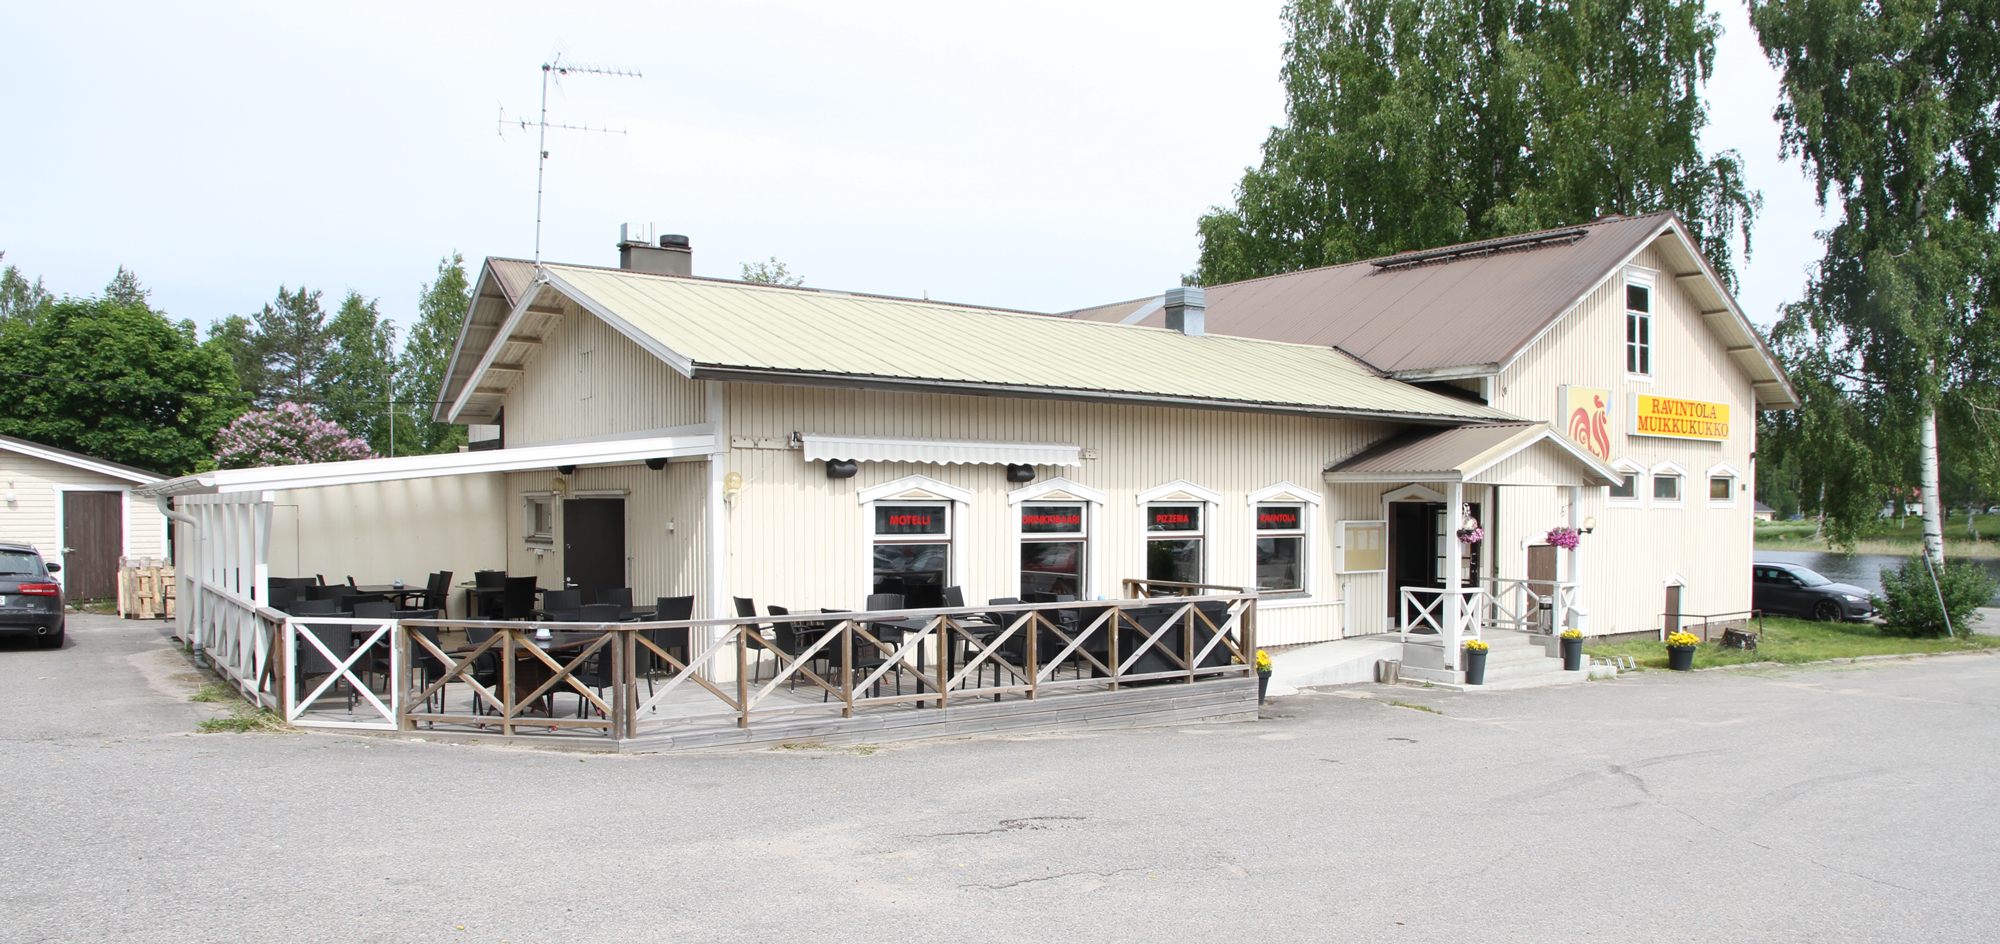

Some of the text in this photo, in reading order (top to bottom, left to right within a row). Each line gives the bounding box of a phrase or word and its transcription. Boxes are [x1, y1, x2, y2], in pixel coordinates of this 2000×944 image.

[1651, 398, 1717, 419] RAVINTOLA
[1637, 415, 1729, 437] MUIKKUKUKKO
[889, 515, 931, 525] MOTELLI
[1022, 515, 1080, 525] DRINKKIBAARI
[1156, 514, 1190, 523] PIZZERIA
[1260, 514, 1296, 522] RAVINTOLA
